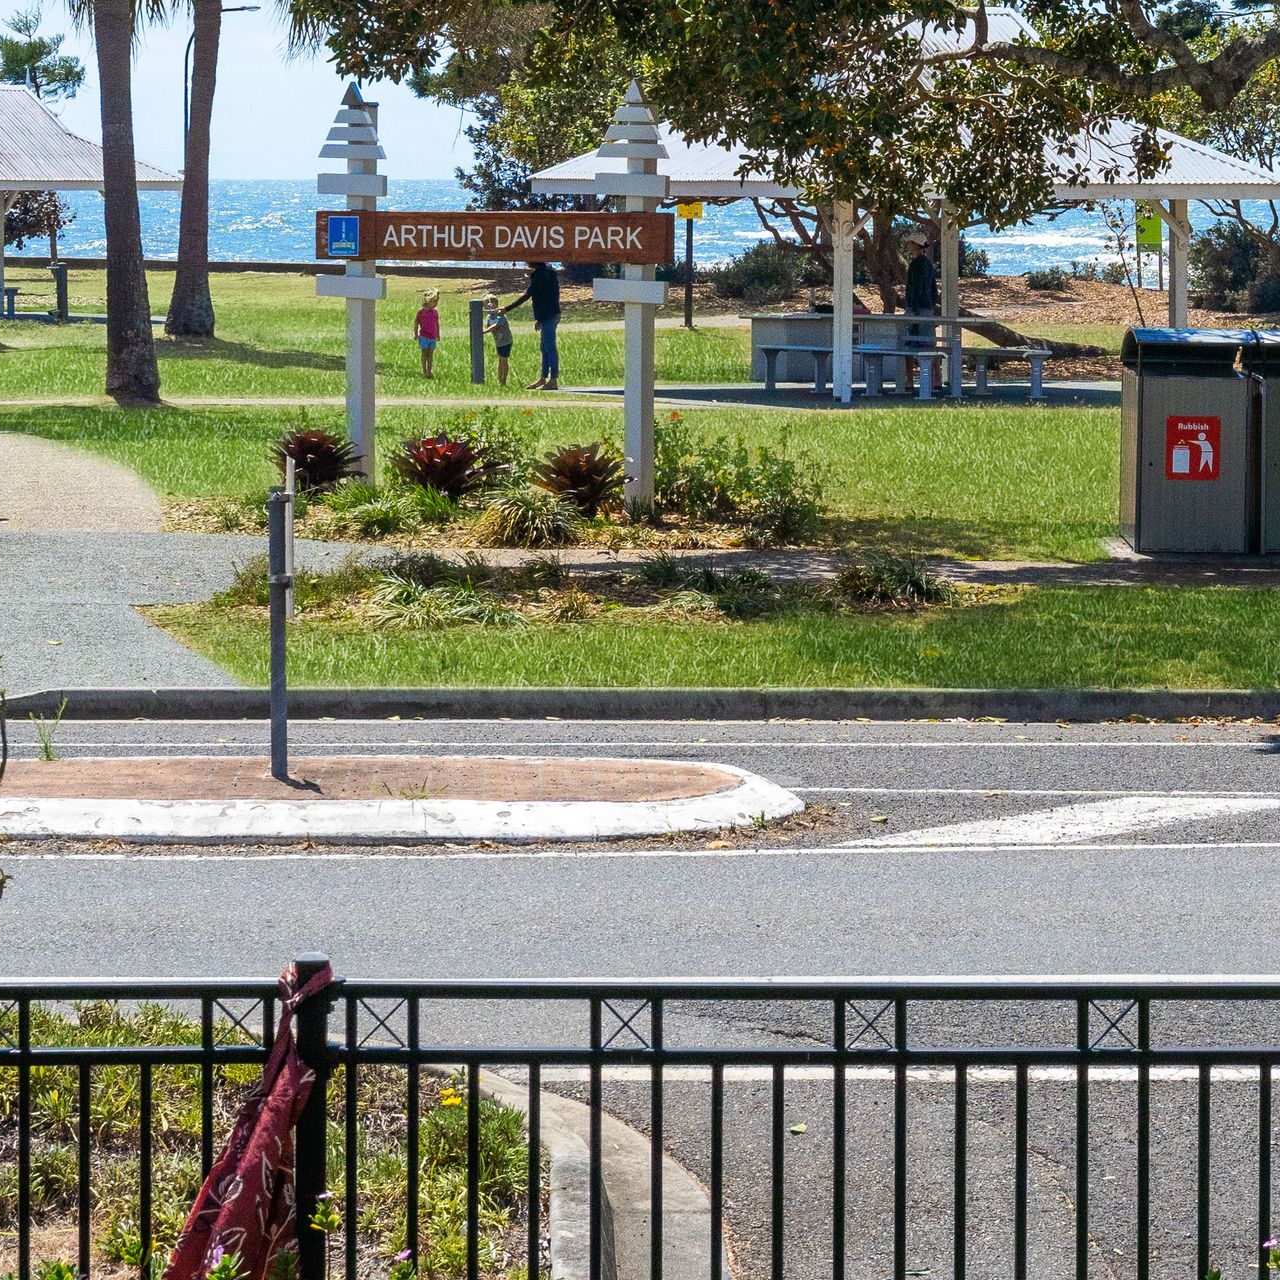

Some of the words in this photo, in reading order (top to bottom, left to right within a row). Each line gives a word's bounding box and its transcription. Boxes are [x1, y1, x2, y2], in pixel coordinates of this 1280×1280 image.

[383, 225, 484, 248] ARTHUR
[495, 226, 564, 248] DAVIS
[575, 226, 643, 249] PARK
[1177, 422, 1209, 431] Rubbish
